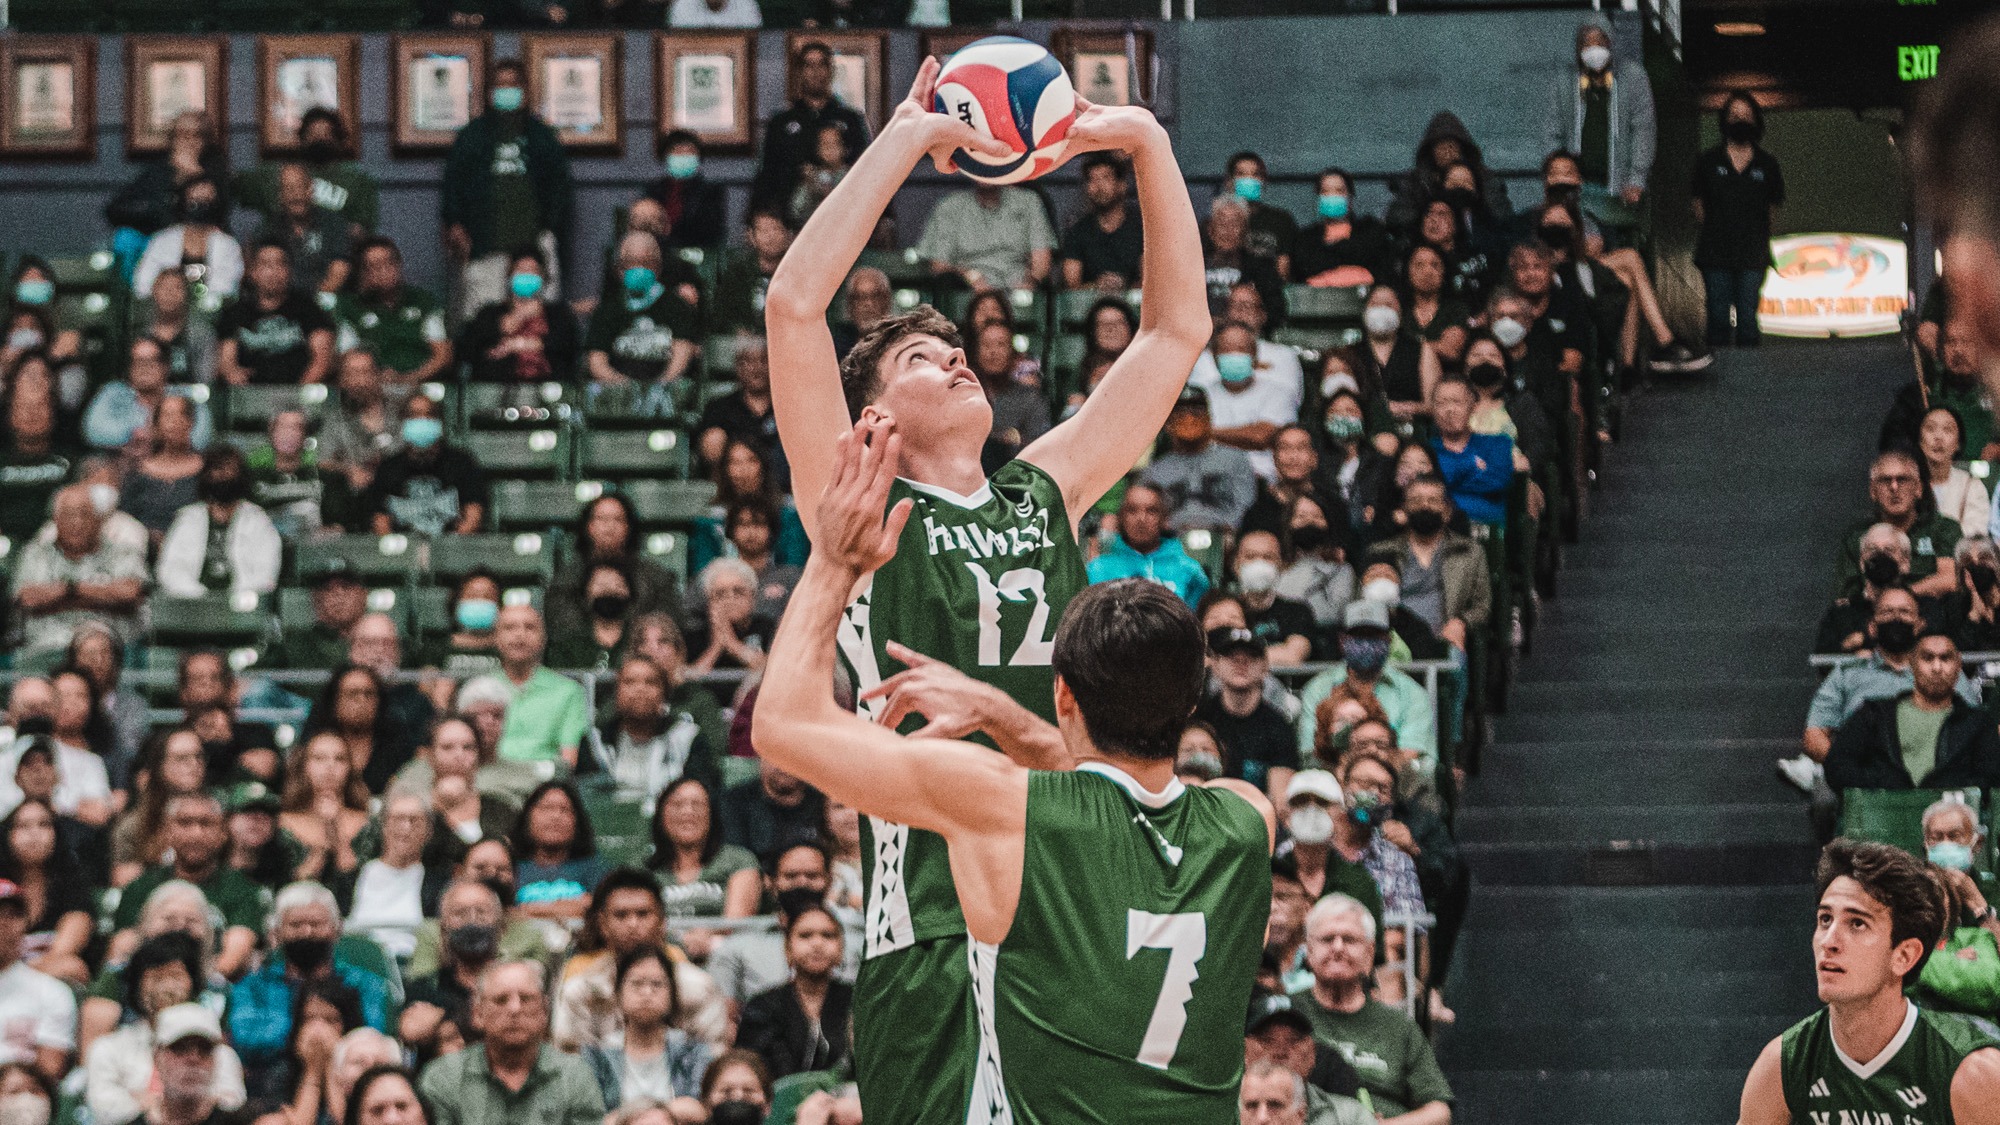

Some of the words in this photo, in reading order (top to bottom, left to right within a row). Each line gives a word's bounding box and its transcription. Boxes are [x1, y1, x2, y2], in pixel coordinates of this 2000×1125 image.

[1898, 45, 1940, 81] EXIT
[964, 561, 1056, 666] 12
[1127, 907, 1207, 1071] 7
